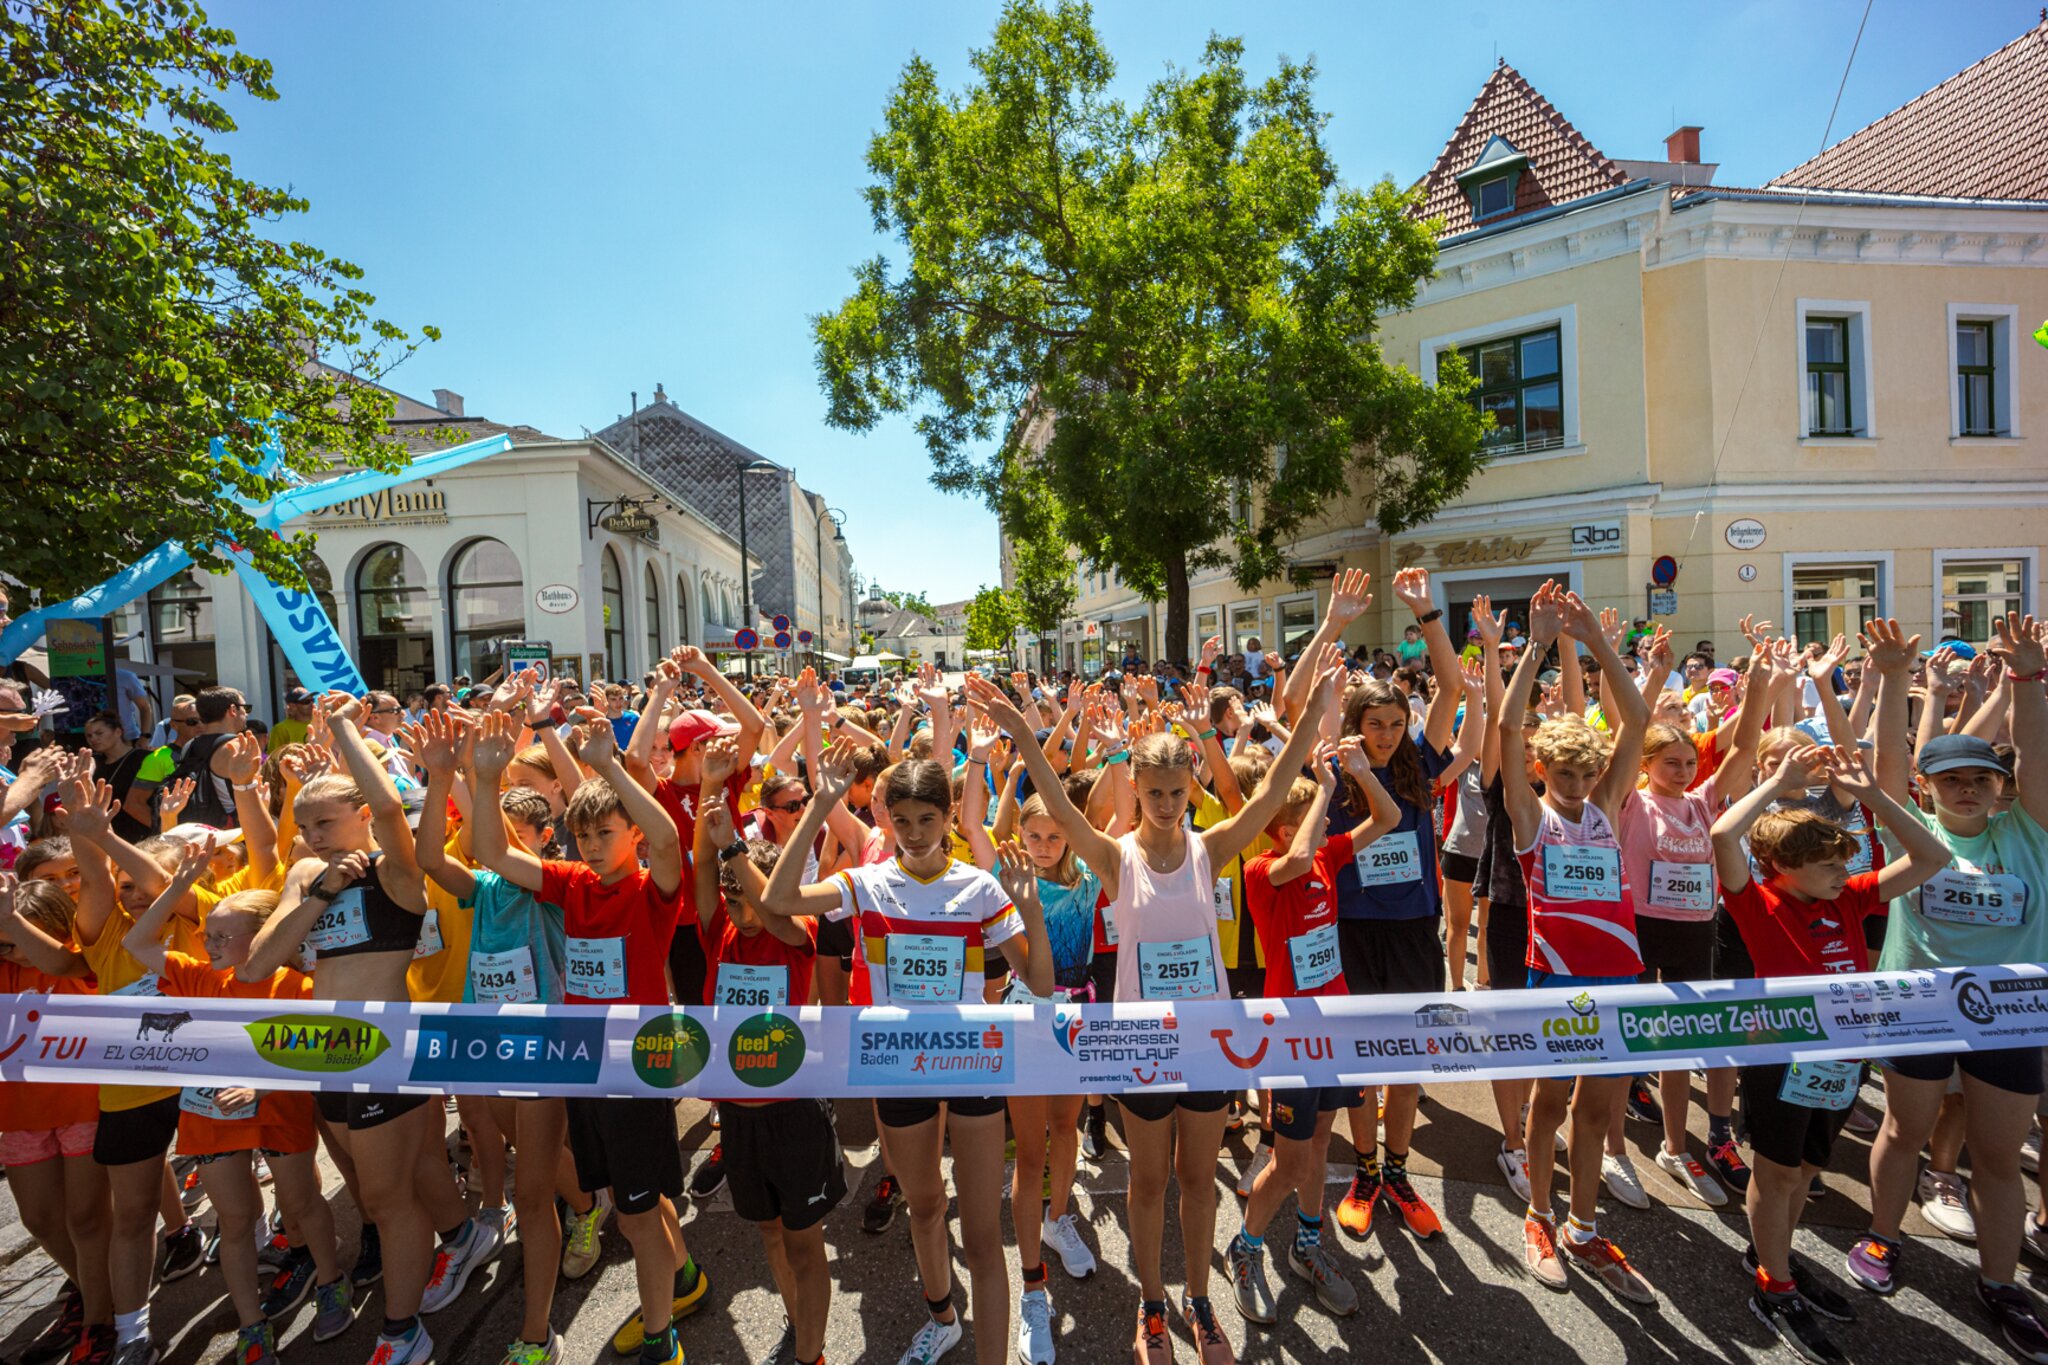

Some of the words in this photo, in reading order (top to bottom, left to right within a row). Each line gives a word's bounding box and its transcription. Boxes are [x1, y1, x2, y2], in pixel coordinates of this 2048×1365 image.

[305, 488, 446, 519] erMann
[1572, 525, 1620, 545] Qbo
[1435, 537, 1548, 567] Tchibo
[1372, 851, 1409, 867] 2590
[1563, 864, 1605, 881] 2569
[1667, 879, 1702, 894] 2504
[1943, 888, 2003, 908] 2615
[1308, 945, 1336, 968] 2591
[571, 959, 605, 977] 2554
[903, 958, 948, 977] 2635
[1158, 960, 1200, 979] 2557
[480, 970, 516, 988] 2434
[726, 987, 770, 1006] 2636
[1090, 1020, 1160, 1032] BADENER
[1542, 1016, 1600, 1037] raw
[1621, 1006, 1727, 1040] Badener
[1728, 1001, 1818, 1036] Zeitung
[1834, 1008, 1902, 1028] m.berger
[40, 1036, 88, 1060] TUI
[261, 1024, 372, 1053] ADAMAH
[636, 1035, 673, 1053] soja
[736, 1034, 769, 1051] feel
[861, 1030, 980, 1051] SPARKASSE
[1078, 1034, 1180, 1046] SPARKASSEN
[1355, 1032, 1537, 1058] ENGEL&VÖLKERS
[1546, 1038, 1604, 1053] ENERGY
[103, 1044, 125, 1061] EL
[129, 1046, 209, 1062] GAUCHO
[428, 1037, 590, 1061] BIOGENA
[1079, 1047, 1181, 1062] STADTLAUF
[1285, 1037, 1334, 1060] TUI
[325, 1053, 364, 1066] BioHof
[735, 1053, 777, 1070] good
[861, 1053, 899, 1066] Baden
[932, 1053, 1004, 1073] running
[1432, 1063, 1477, 1074] Baden
[1079, 1073, 1116, 1084] presented
[1118, 1074, 1134, 1084] by
[1163, 1071, 1183, 1082] TUI
[1806, 1074, 1846, 1093] 2498
